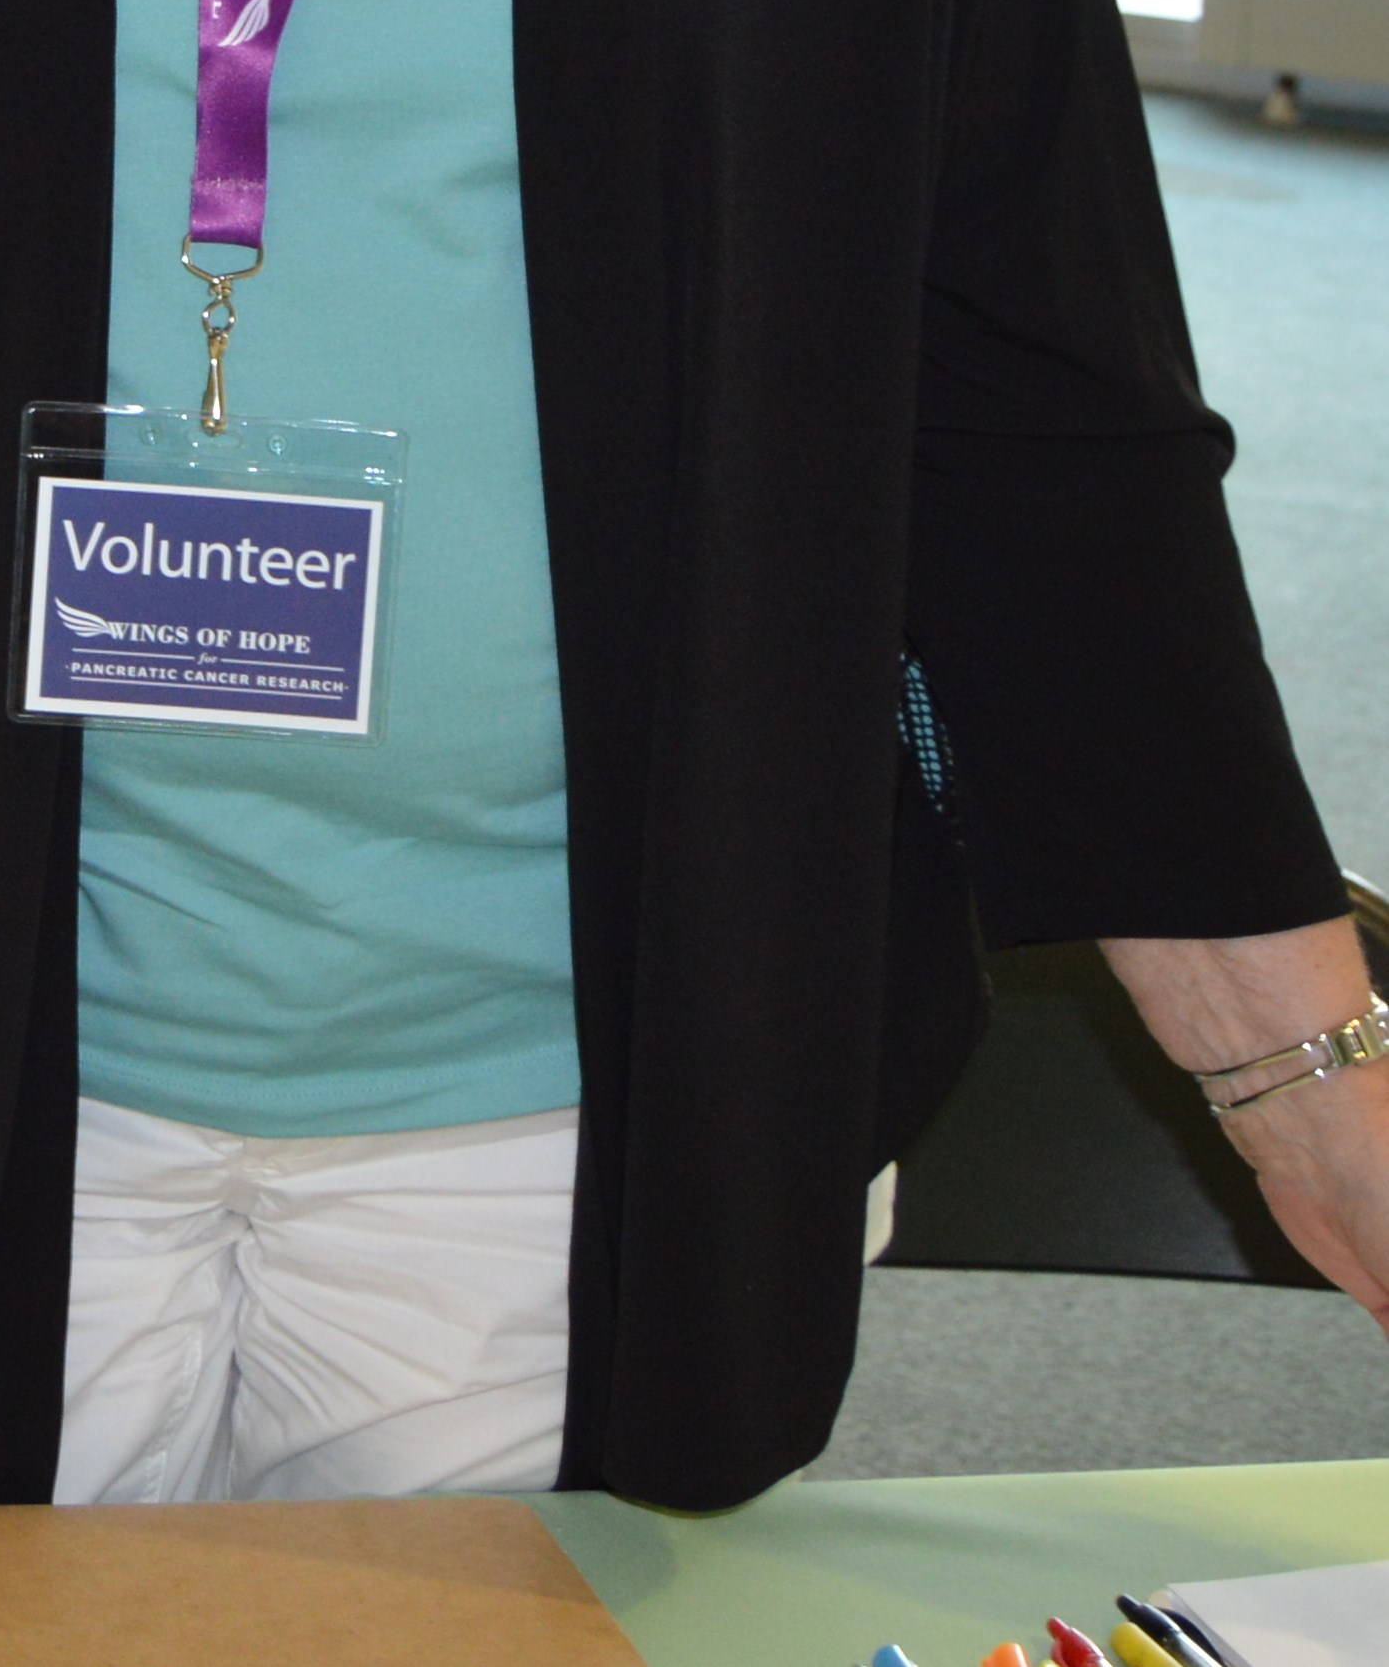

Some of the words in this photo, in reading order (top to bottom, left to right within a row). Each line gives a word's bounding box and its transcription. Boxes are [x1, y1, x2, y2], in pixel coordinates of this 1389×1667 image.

[63, 519, 356, 590] Volunteer
[108, 621, 189, 645] WINGS
[197, 628, 232, 648] OF
[238, 631, 311, 654] HOPE
[197, 653, 218, 665] for
[72, 662, 178, 680] PANCREATIC
[184, 669, 250, 685] CANCER
[256, 676, 344, 693] RESEARCH
